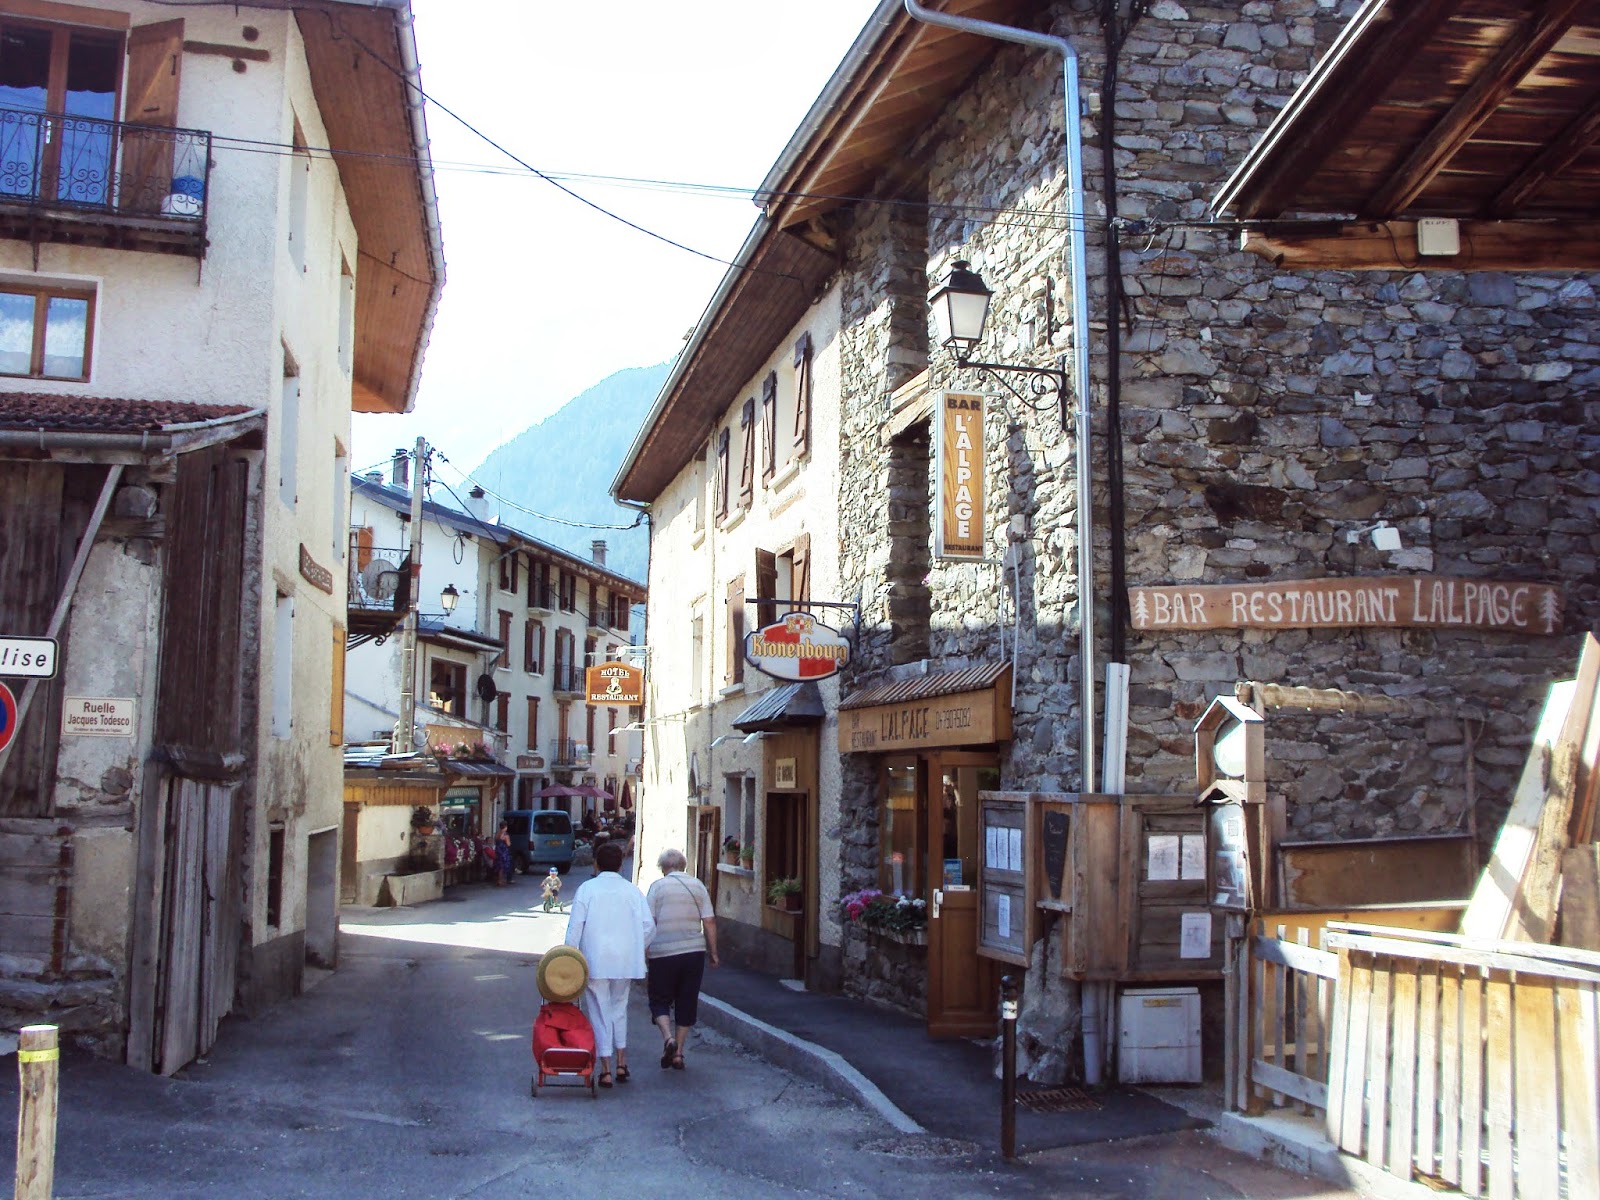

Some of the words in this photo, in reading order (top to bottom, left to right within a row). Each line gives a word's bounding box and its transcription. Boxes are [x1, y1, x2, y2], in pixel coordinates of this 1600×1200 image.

[947, 399, 981, 411] BAR
[955, 414, 973, 538] L'ALPAGE
[1153, 592, 1207, 624] BAR
[1232, 588, 1399, 623] RESTAURANT
[752, 634, 849, 665] Kronenbourg
[601, 667, 630, 677] HOTEL
[83, 702, 115, 713] Ruelle
[68, 714, 98, 727] Jacques
[100, 715, 130, 726] Todesco
[881, 708, 929, 741] L'ALPAGE
